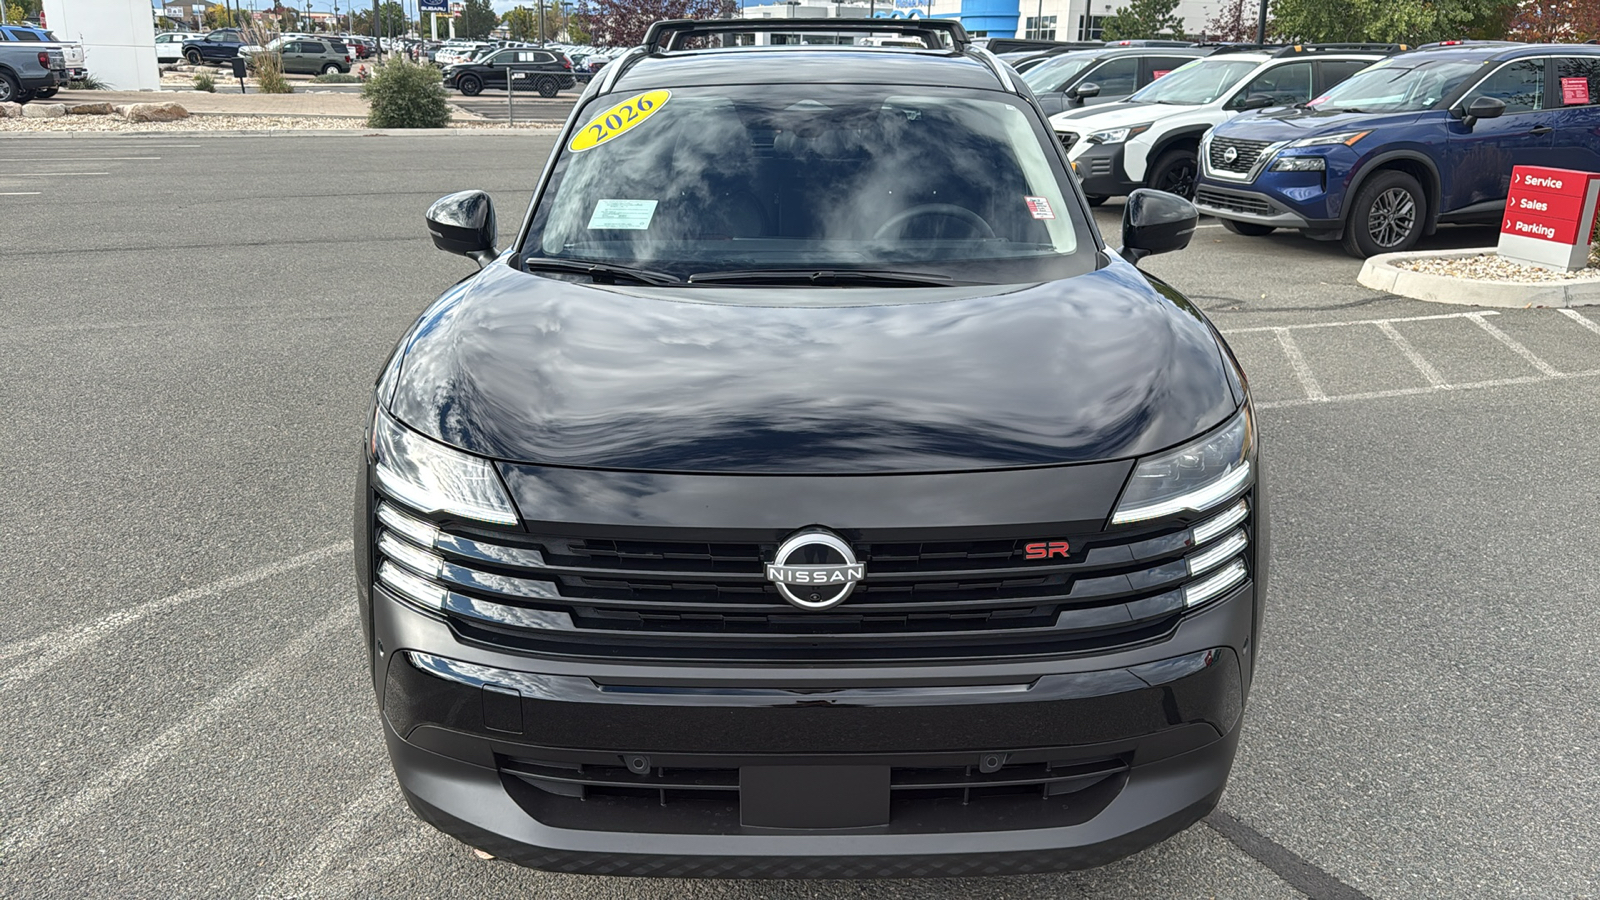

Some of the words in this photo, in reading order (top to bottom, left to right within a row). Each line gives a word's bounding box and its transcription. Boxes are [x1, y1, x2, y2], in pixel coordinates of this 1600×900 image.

[589, 95, 653, 142] 2026
[1524, 175, 1562, 189] Service
[1520, 198, 1548, 211] Sales
[1515, 221, 1555, 239] Parking
[1026, 541, 1070, 559] SR
[769, 567, 862, 583] NISSAN
